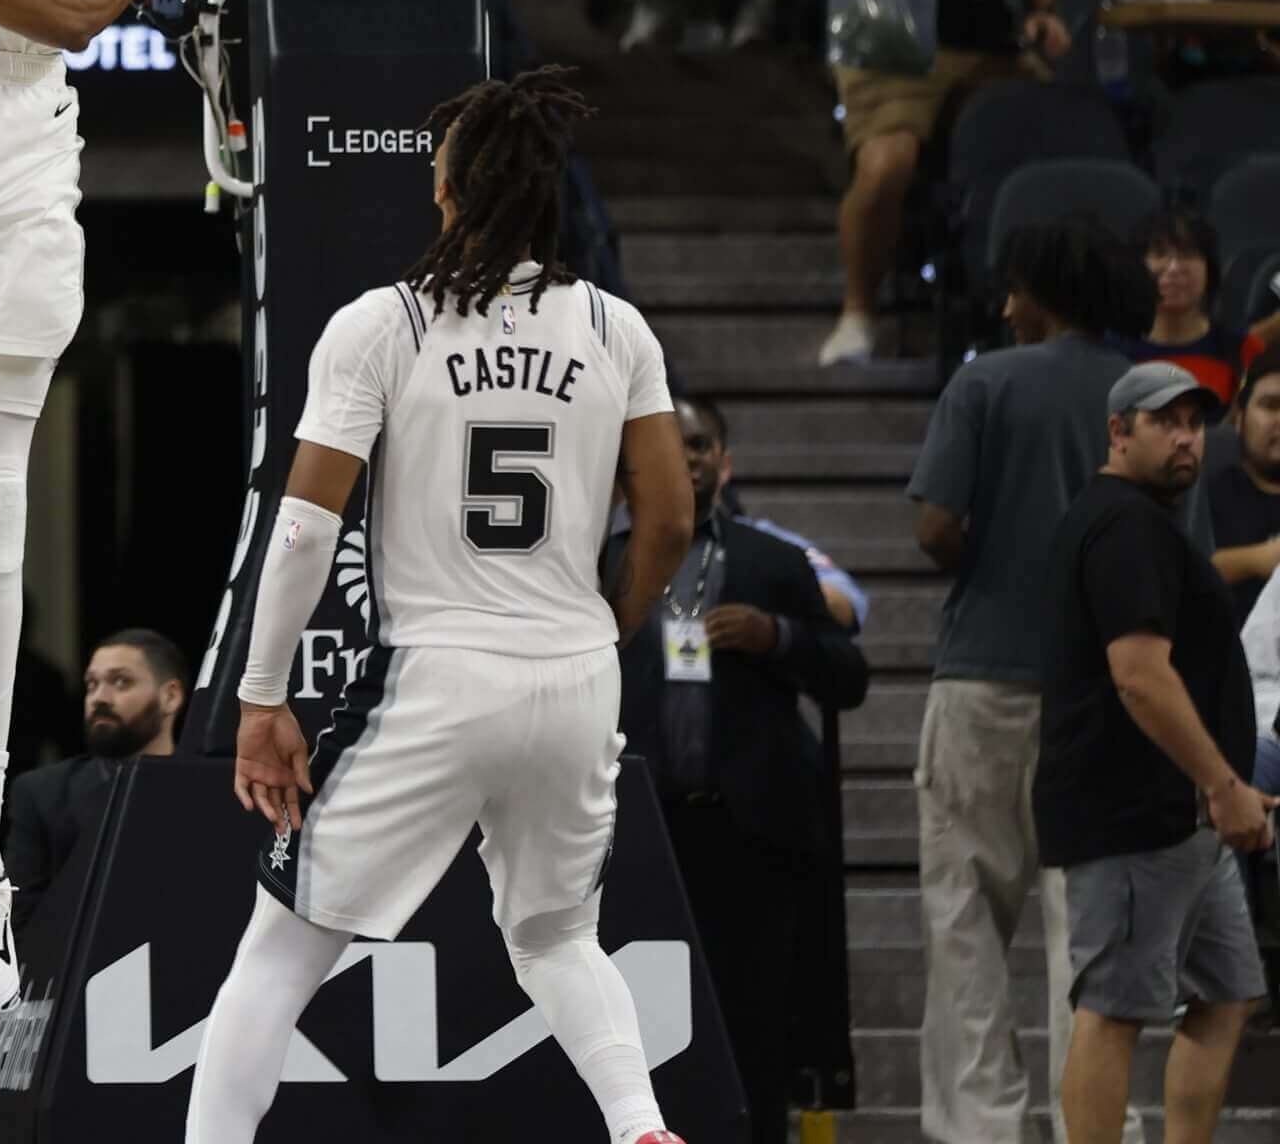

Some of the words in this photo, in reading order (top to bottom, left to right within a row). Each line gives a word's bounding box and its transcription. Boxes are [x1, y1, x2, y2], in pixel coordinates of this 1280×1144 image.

[327, 128, 433, 154] LEDGER
[446, 345, 585, 404] CASTLE
[461, 420, 556, 557] 5
[294, 629, 375, 698] Fr
